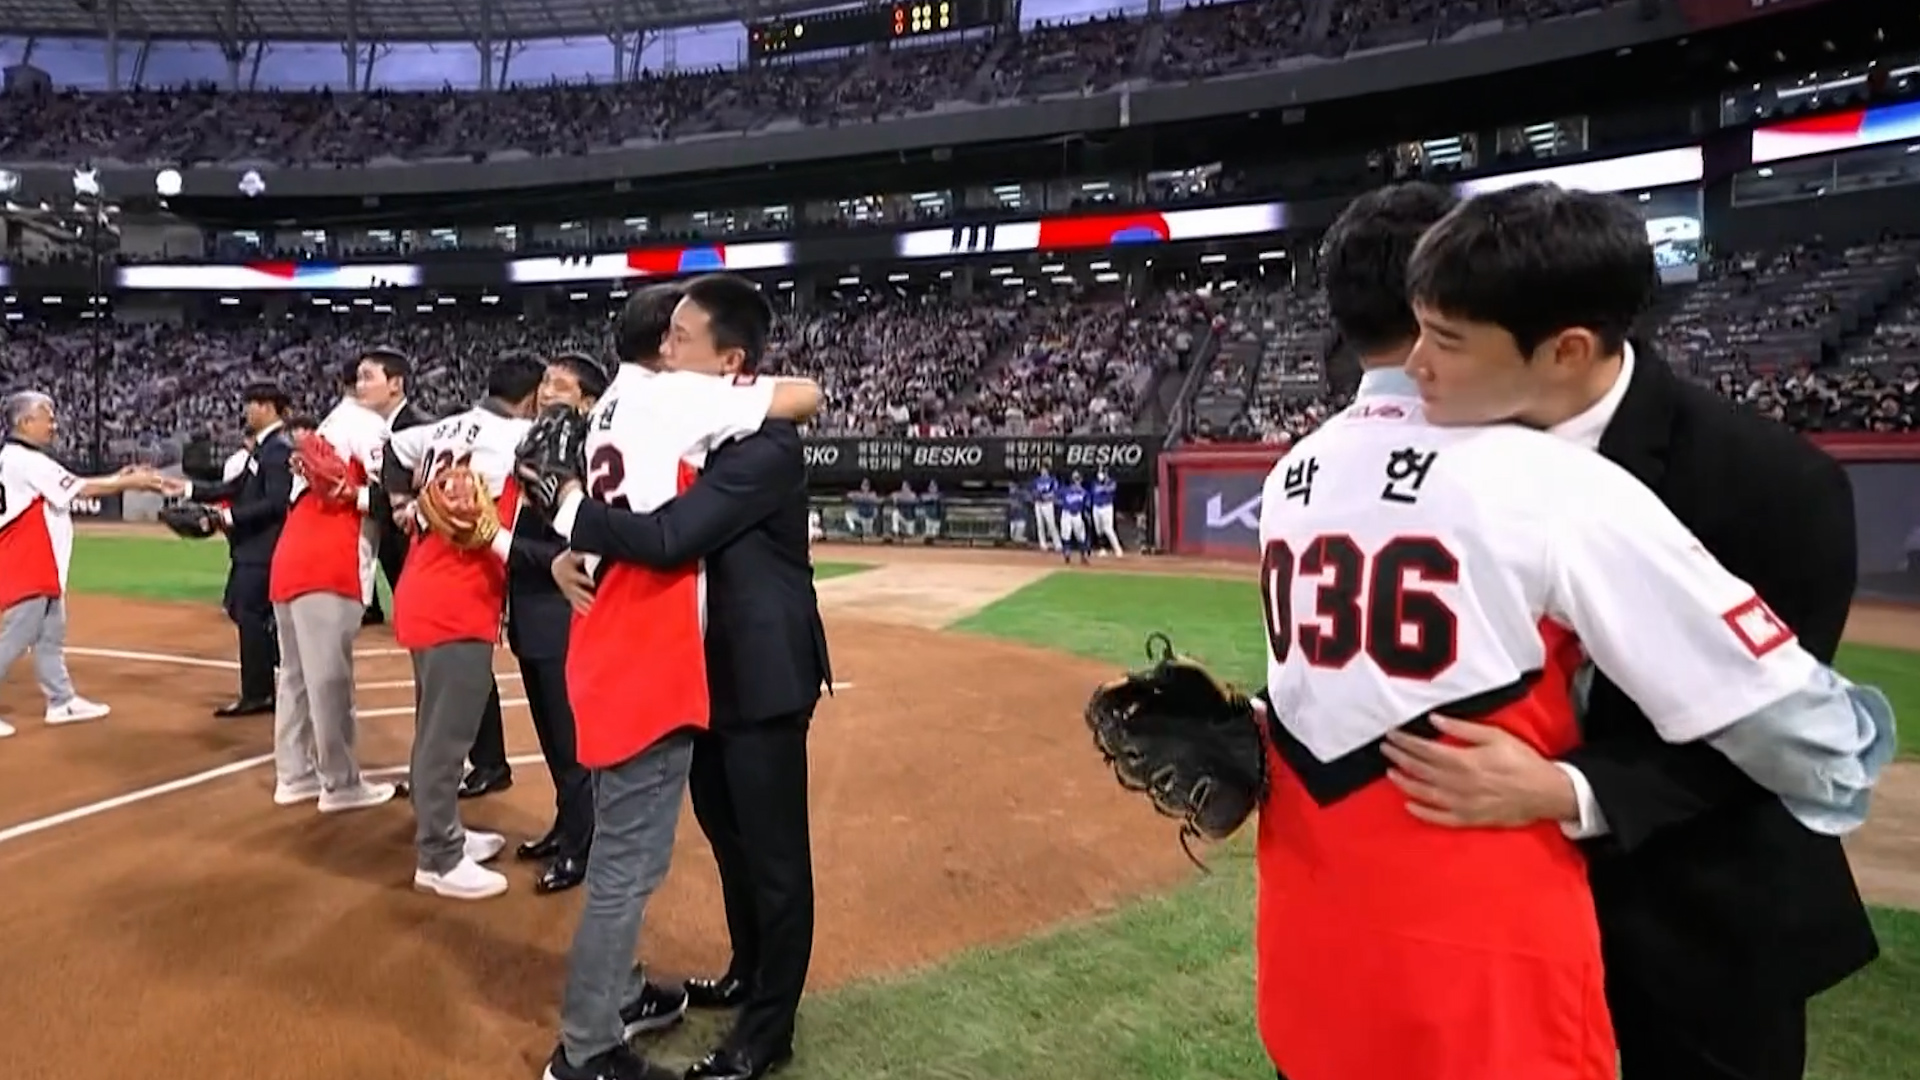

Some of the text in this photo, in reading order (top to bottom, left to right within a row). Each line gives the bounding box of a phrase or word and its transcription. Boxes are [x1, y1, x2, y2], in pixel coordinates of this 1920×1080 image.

[591, 444, 631, 508] 2
[803, 445, 839, 467] SKO
[913, 444, 983, 467] BESKO
[1066, 443, 1143, 467] BESKO
[1284, 447, 1438, 507] 박 헌
[1261, 533, 1459, 683] 036
